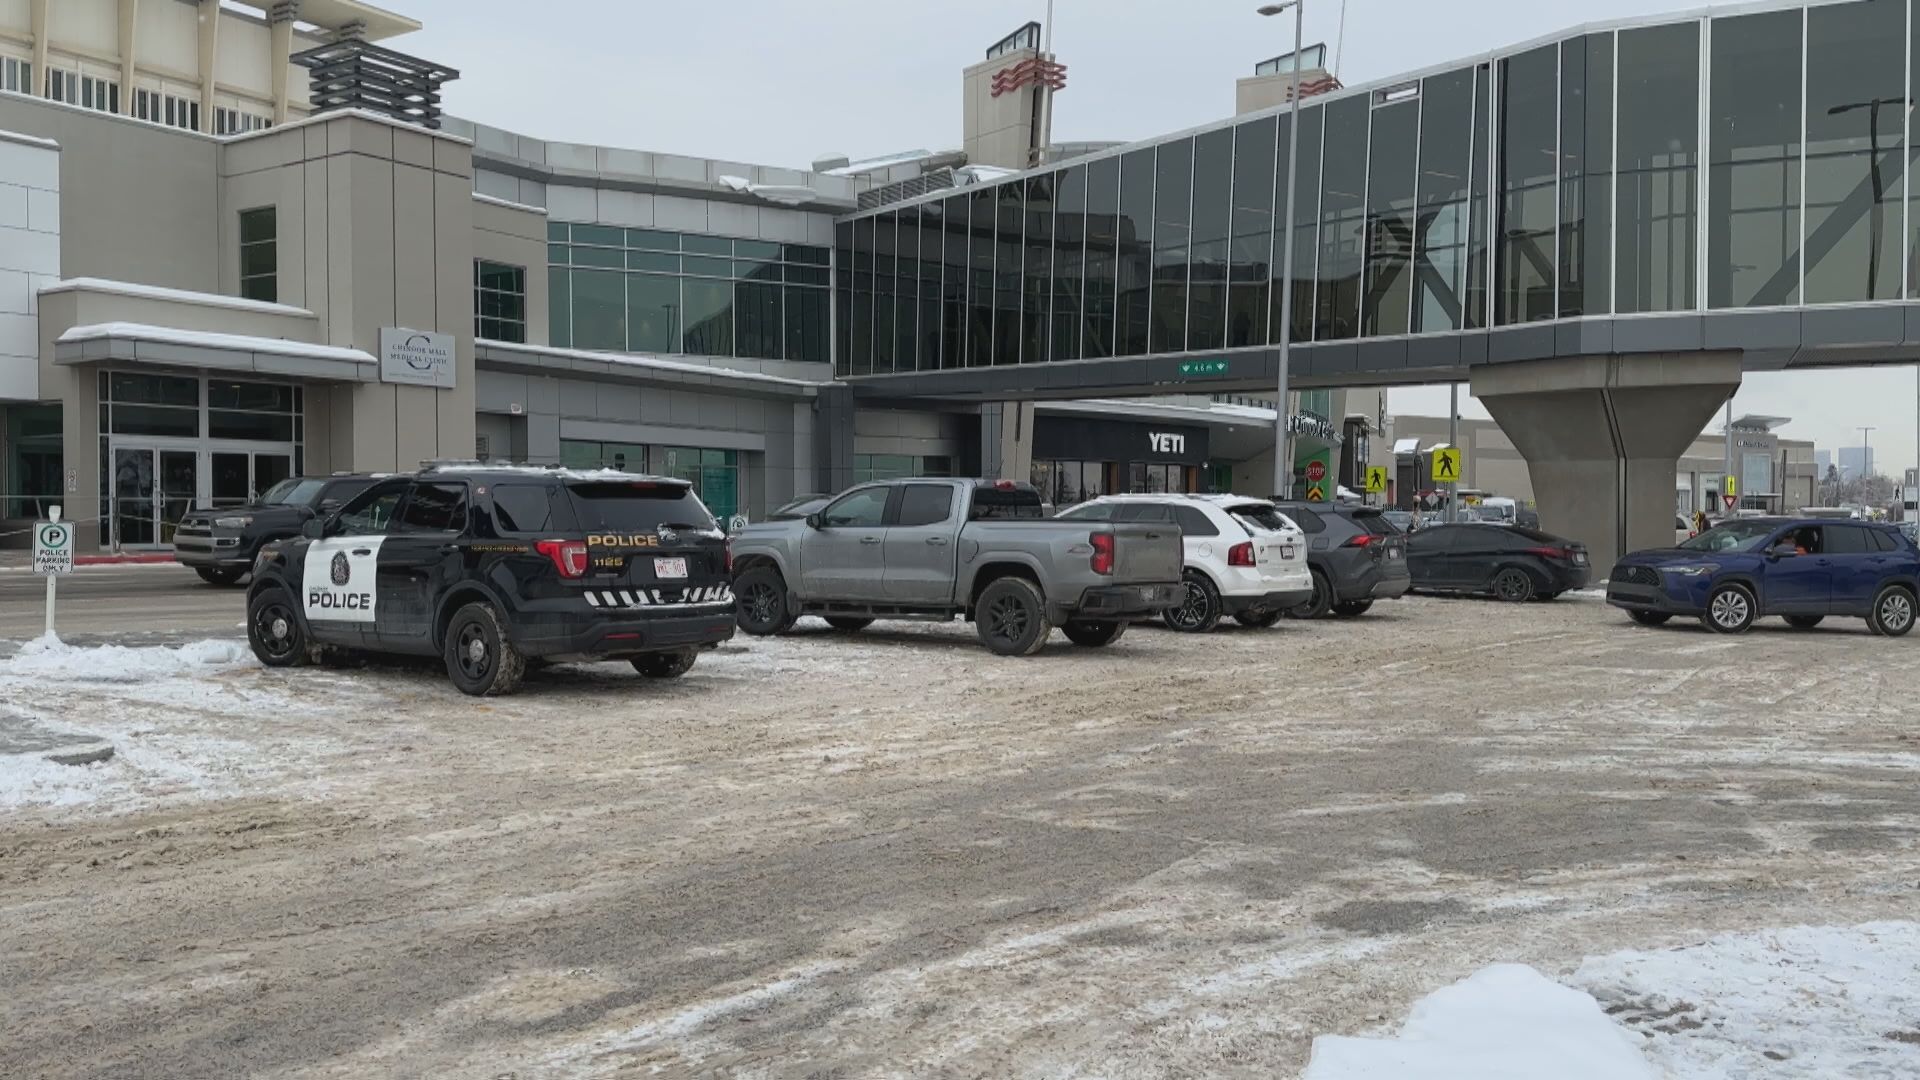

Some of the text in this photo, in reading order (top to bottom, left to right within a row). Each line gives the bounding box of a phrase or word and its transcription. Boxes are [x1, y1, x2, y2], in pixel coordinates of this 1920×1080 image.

[390, 353, 423, 362] MEDICAL
[1148, 432, 1185, 454] YETI
[1307, 466, 1325, 477] STOP
[49, 530, 60, 544] P
[587, 534, 658, 547] POLICE
[309, 592, 371, 610] POLICE
